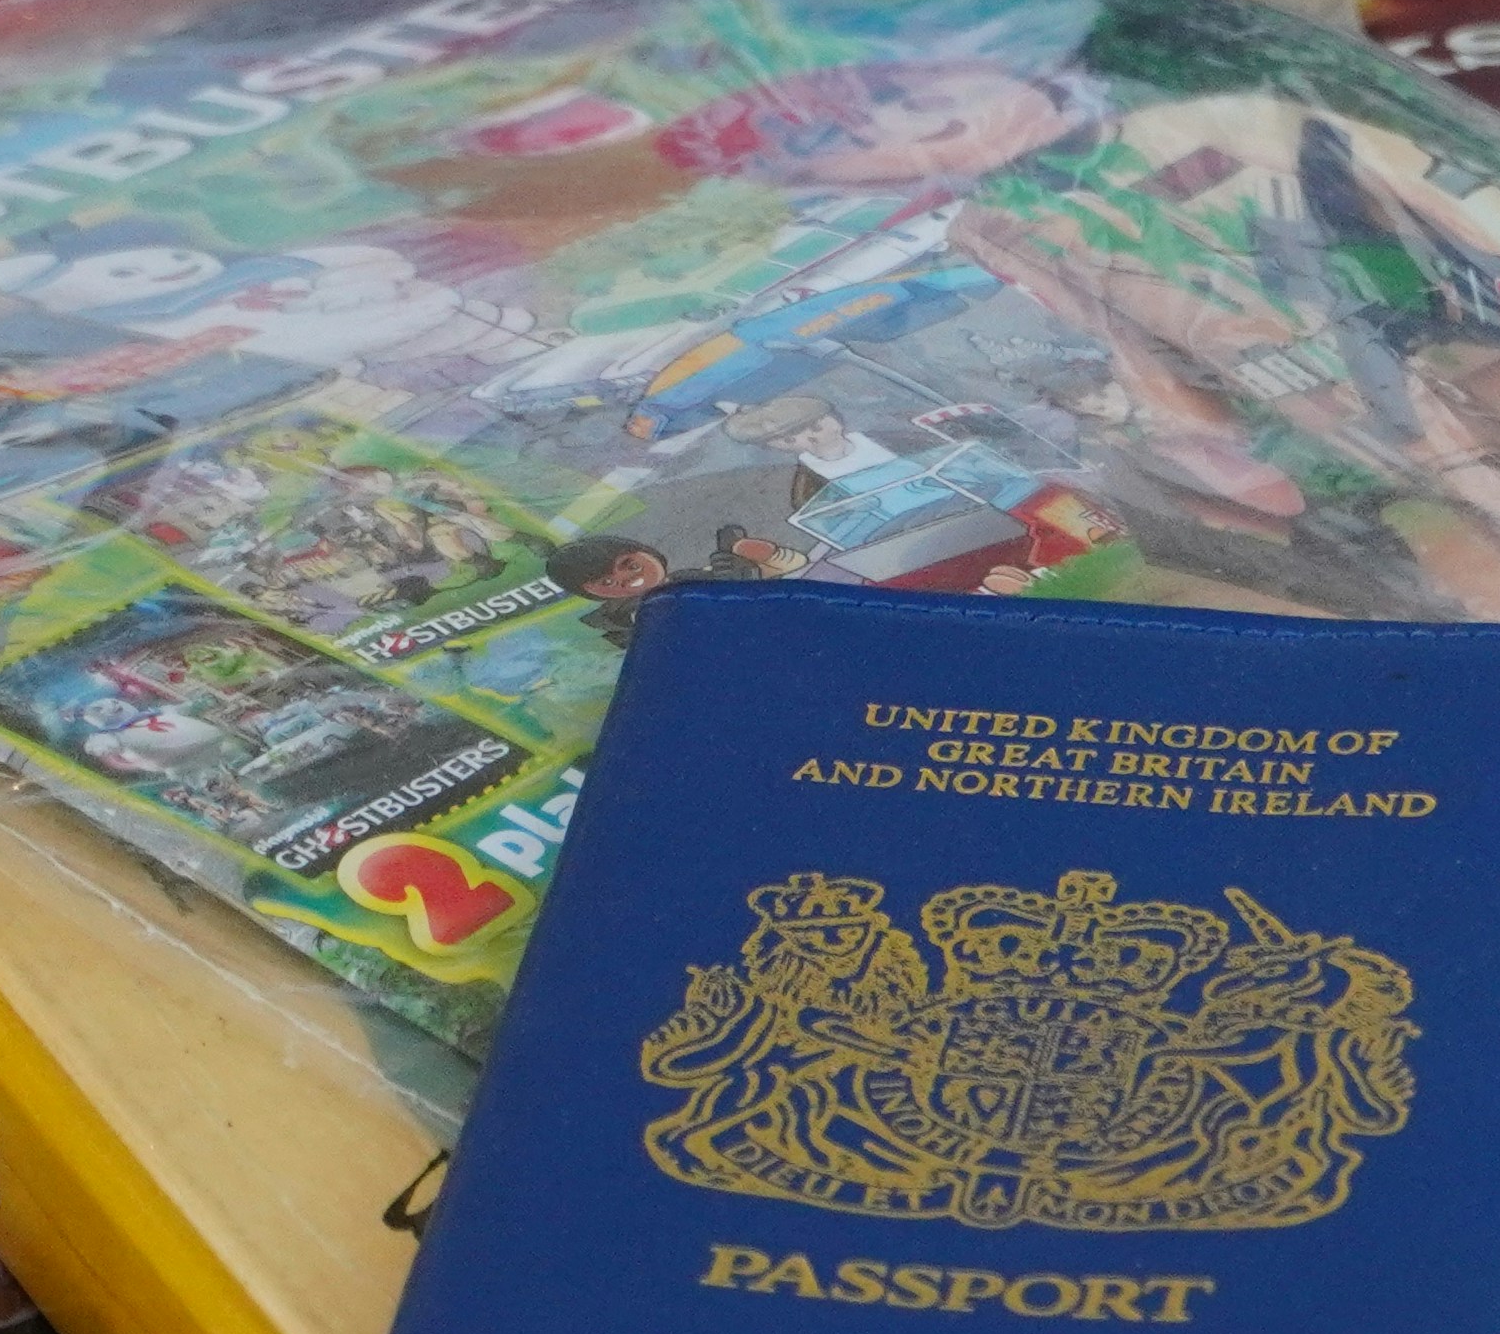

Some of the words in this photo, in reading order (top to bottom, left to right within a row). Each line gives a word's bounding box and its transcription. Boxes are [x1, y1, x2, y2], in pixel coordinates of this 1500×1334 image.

[863, 701, 1059, 742] UNITED
[1066, 716, 1321, 758] KINGDOM
[1326, 729, 1399, 759] OF
[792, 756, 902, 791] AND
[913, 766, 1199, 811] NORTHERN
[1209, 785, 1438, 822] IRELAND
[928, 739, 1093, 774] GREAT
[1106, 748, 1315, 786] BRITAIN
[348, 838, 525, 951] 2
[1038, 1195, 1150, 1227] MON
[697, 1243, 1215, 1325] PASSPORT
